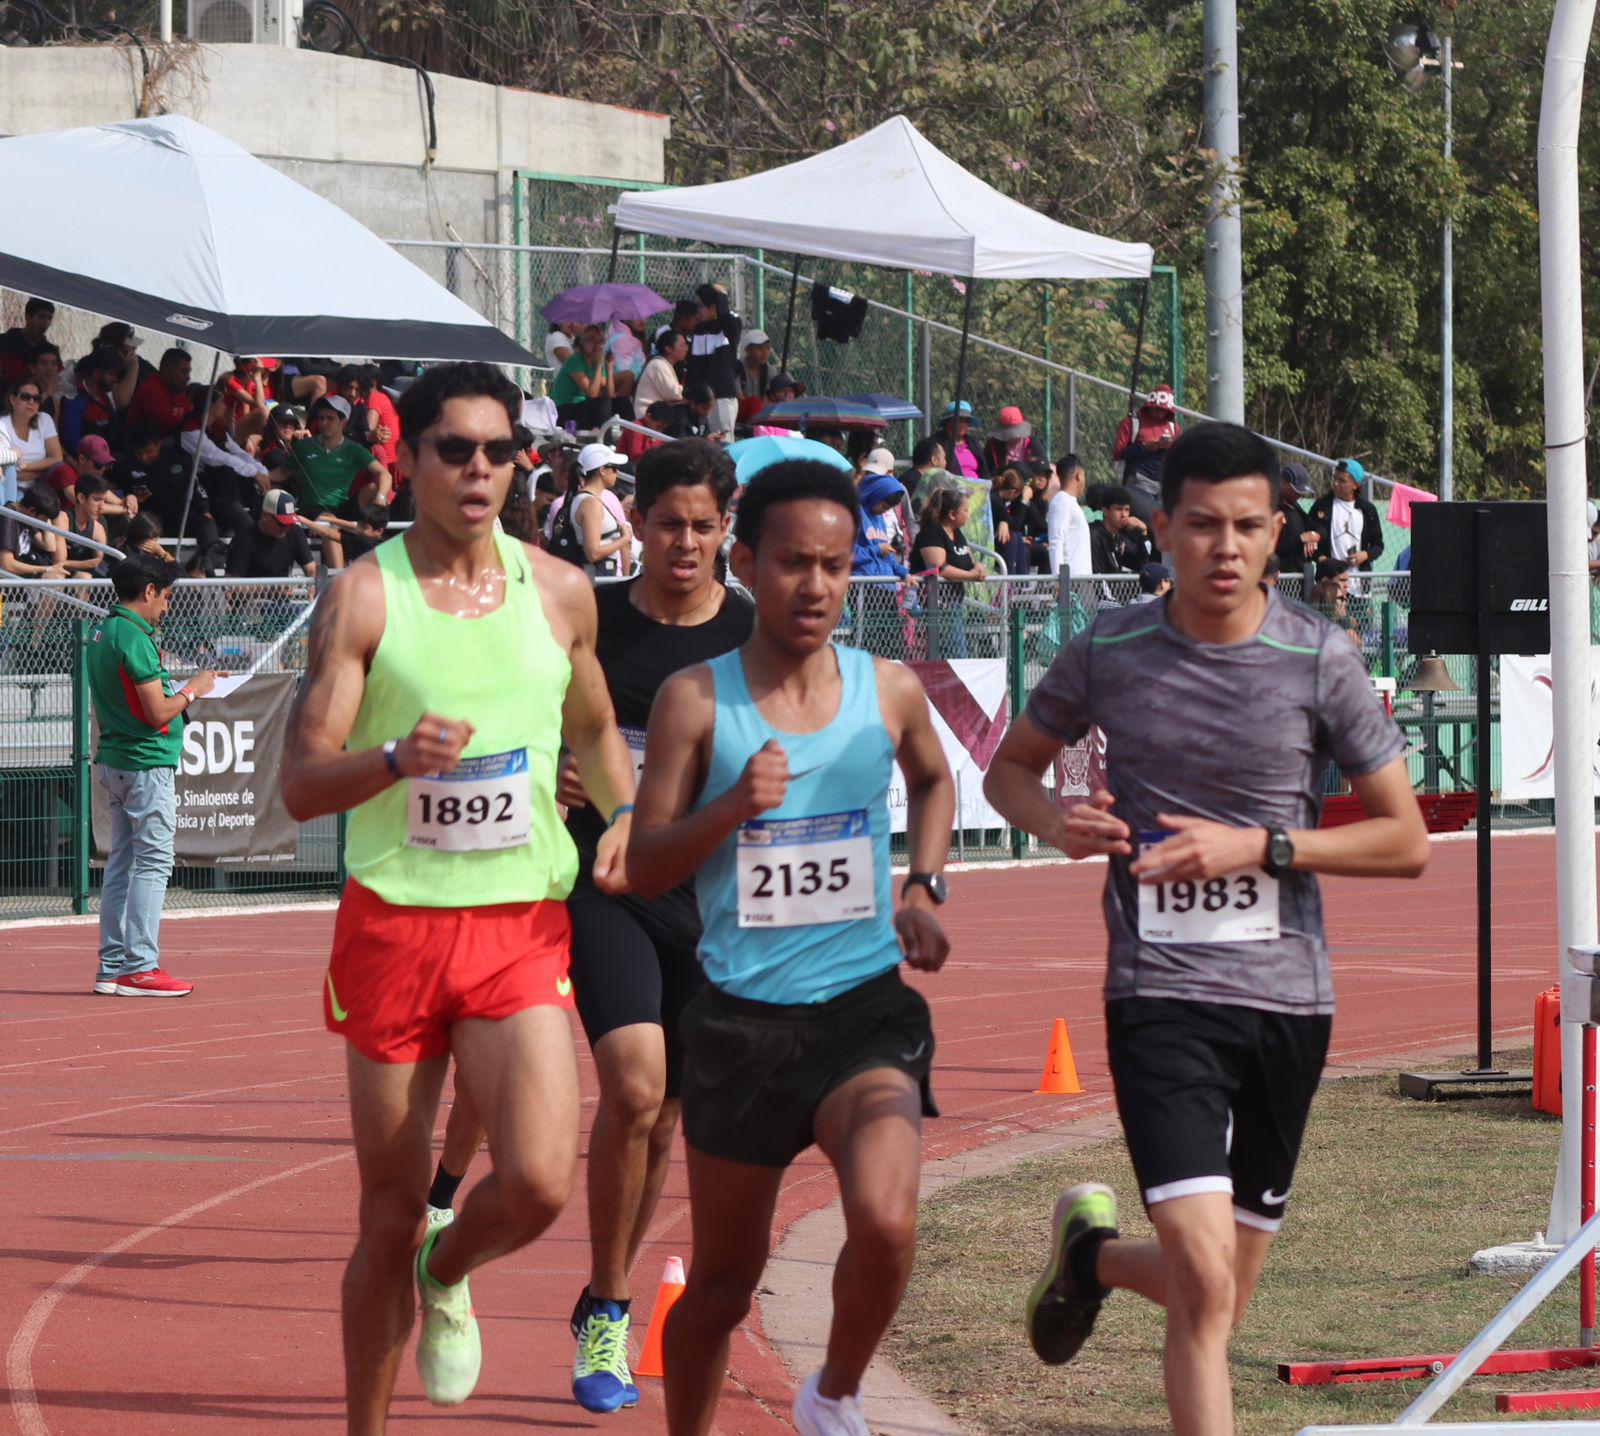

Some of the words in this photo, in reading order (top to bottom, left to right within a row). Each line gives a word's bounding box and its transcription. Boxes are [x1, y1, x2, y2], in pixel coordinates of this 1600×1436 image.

[1510, 599, 1548, 611] GILL
[184, 789, 240, 807] Sinaloense
[242, 788, 255, 805] de
[418, 792, 514, 825] 1892
[200, 816, 207, 831] y
[207, 812, 217, 828] el
[218, 812, 256, 830] Deporte
[751, 856, 851, 898] 2135
[1156, 875, 1259, 913] 1983
